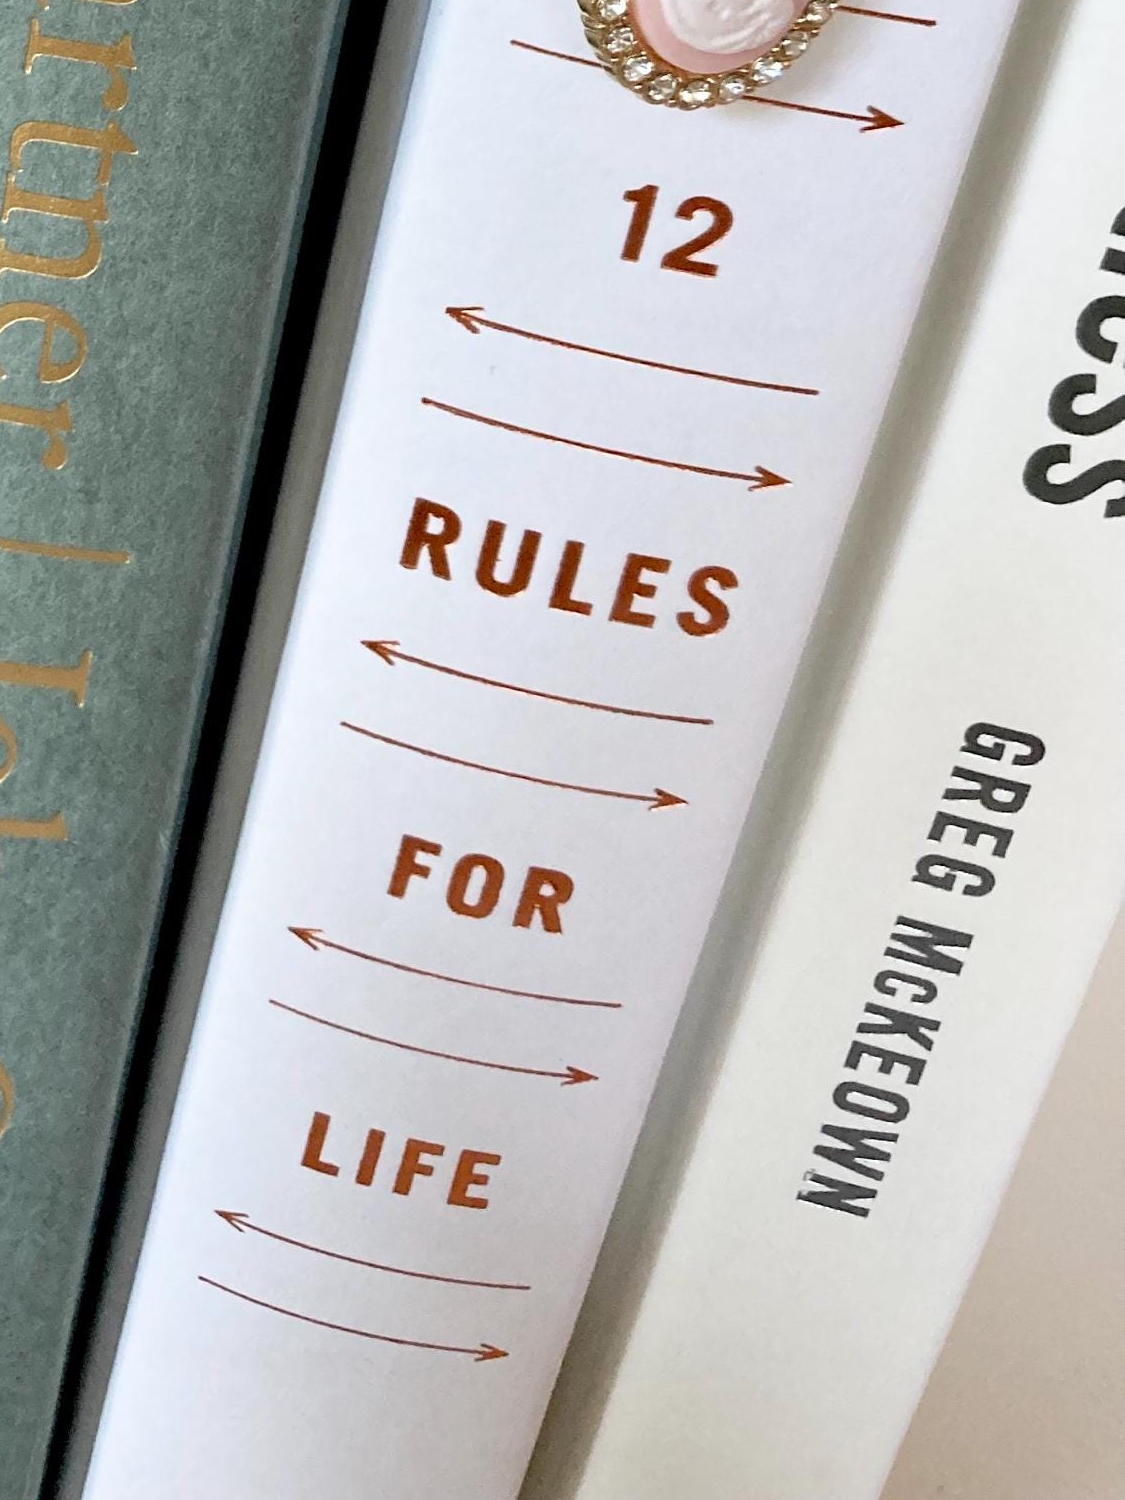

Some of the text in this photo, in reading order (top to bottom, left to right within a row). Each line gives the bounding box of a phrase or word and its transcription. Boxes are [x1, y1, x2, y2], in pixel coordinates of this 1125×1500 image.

[619, 182, 735, 278] 12
[398, 496, 741, 638] RULES
[910, 720, 1046, 899] GREG
[386, 833, 575, 937] FOR
[300, 1111, 502, 1211] LIFE
